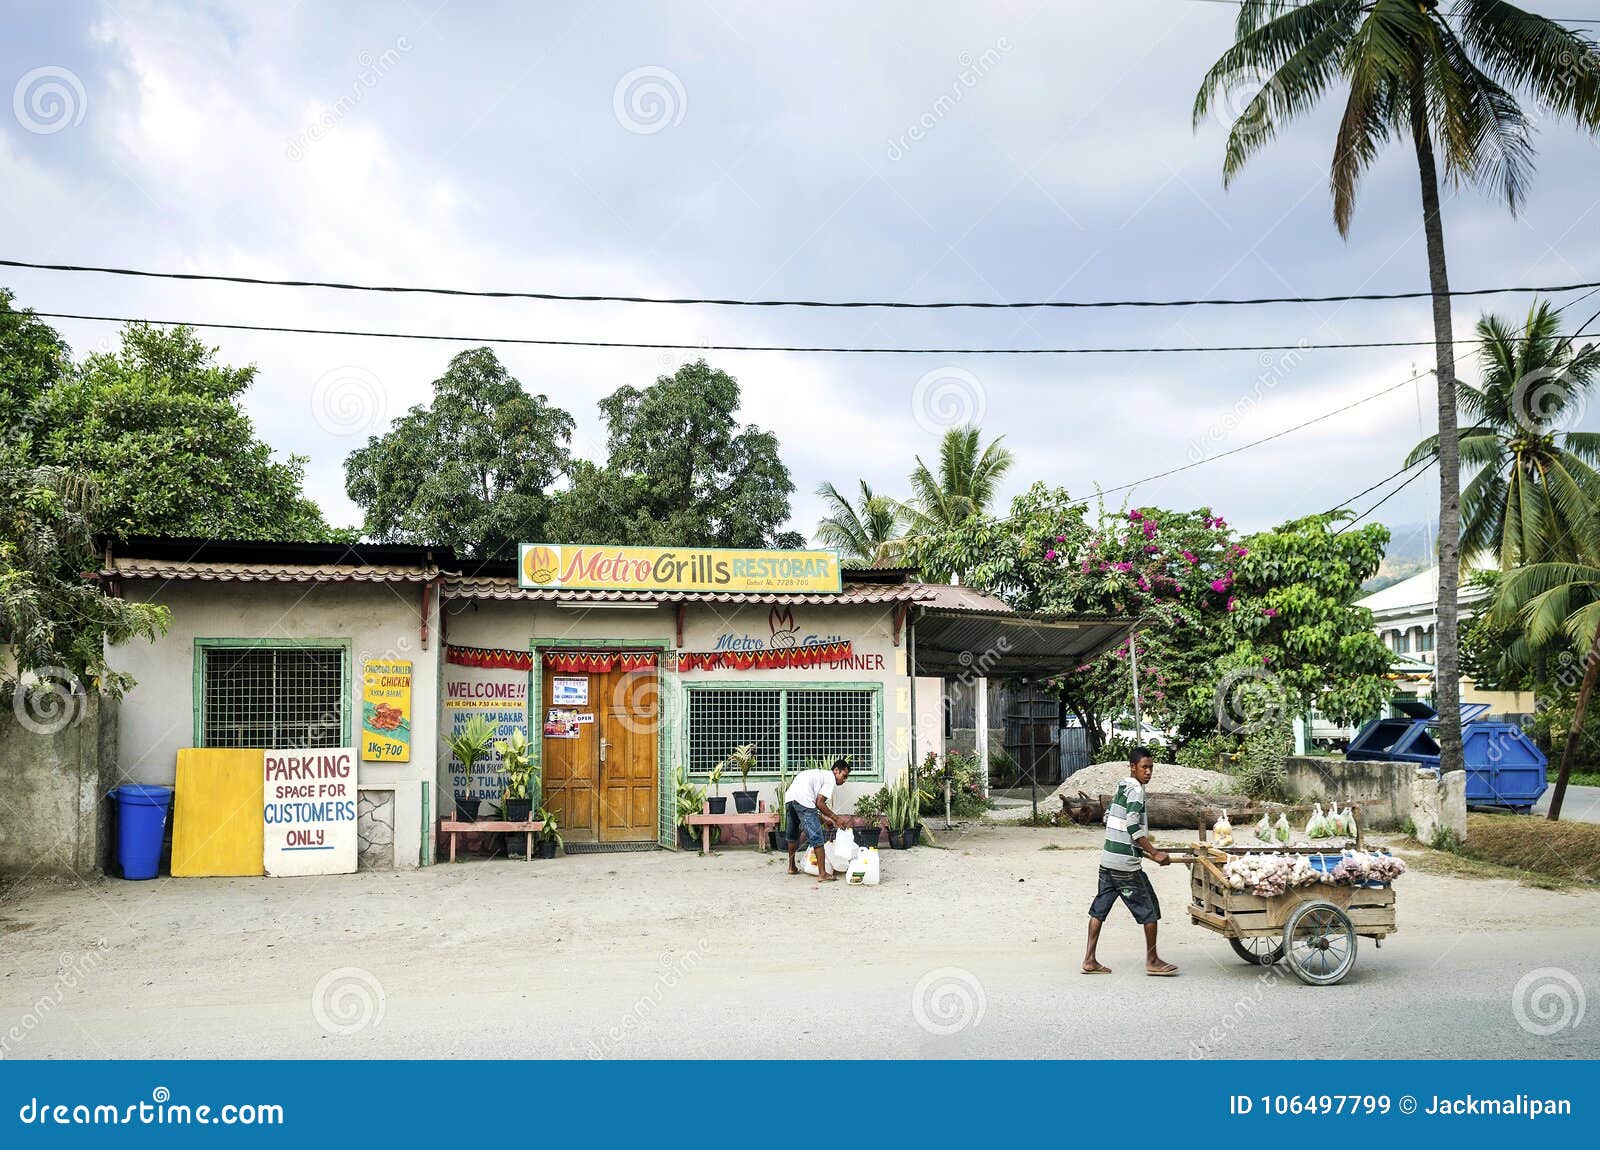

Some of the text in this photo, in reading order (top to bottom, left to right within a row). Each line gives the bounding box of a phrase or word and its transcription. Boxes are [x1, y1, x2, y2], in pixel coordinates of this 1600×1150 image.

[559, 549, 830, 584] Metro Grills RESTOBAR
[714, 633, 765, 650] Metro
[381, 676, 410, 688] CHICKEN
[447, 682, 526, 699] WELCOME!!
[498, 712, 523, 723] BAKAR
[265, 755, 350, 782] PARKING
[448, 763, 467, 774] NAS
[471, 763, 486, 775] KAN
[477, 776, 510, 788] TULAN
[275, 783, 346, 799] SPACE FOR
[480, 789, 502, 800] BAKA
[264, 800, 356, 824] CUSTOMERS
[286, 829, 325, 846] ONLY
